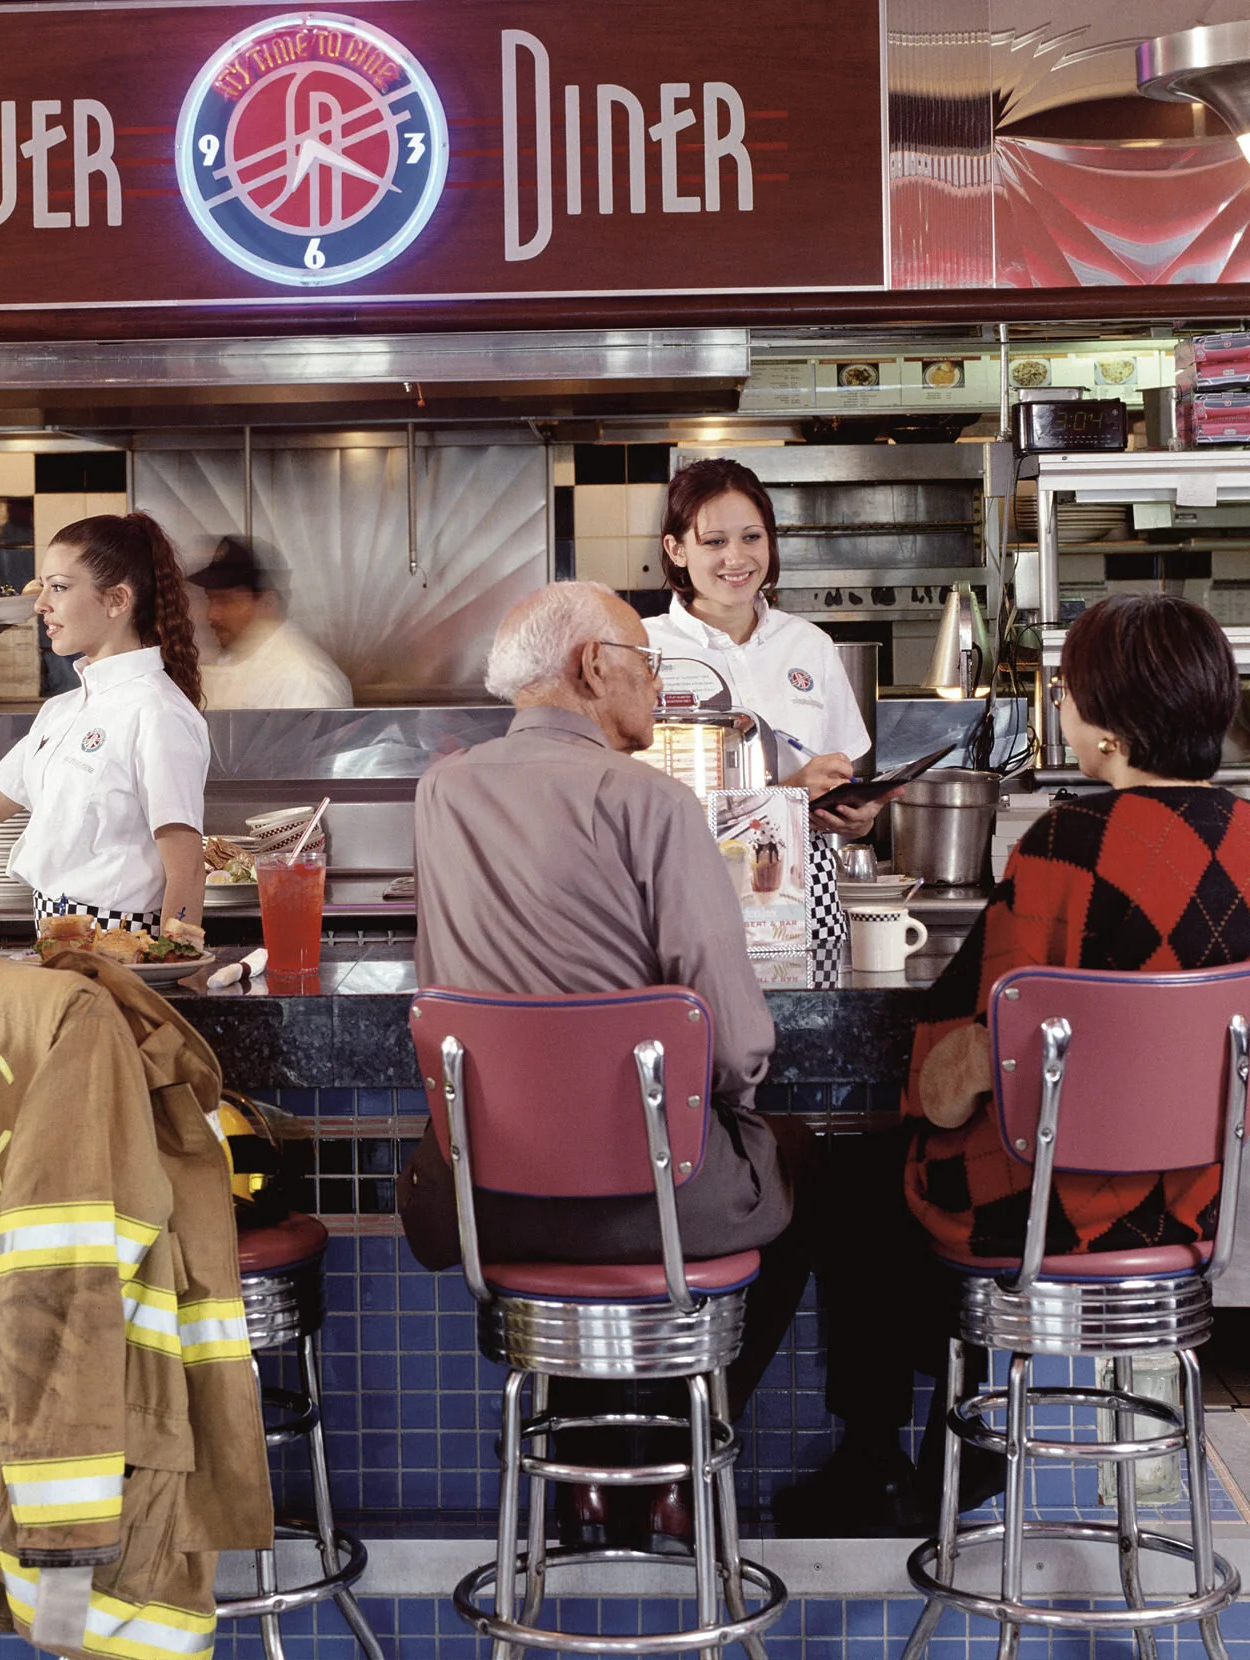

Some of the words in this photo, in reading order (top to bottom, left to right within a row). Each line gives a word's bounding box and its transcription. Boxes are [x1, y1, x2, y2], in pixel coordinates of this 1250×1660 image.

[246, 31, 308, 71] TIME
[315, 29, 342, 58] TO
[345, 36, 400, 95] DINE
[198, 134, 220, 166] 9
[403, 132, 426, 164] 3
[501, 28, 754, 262] DINER
[304, 238, 326, 269] 6
